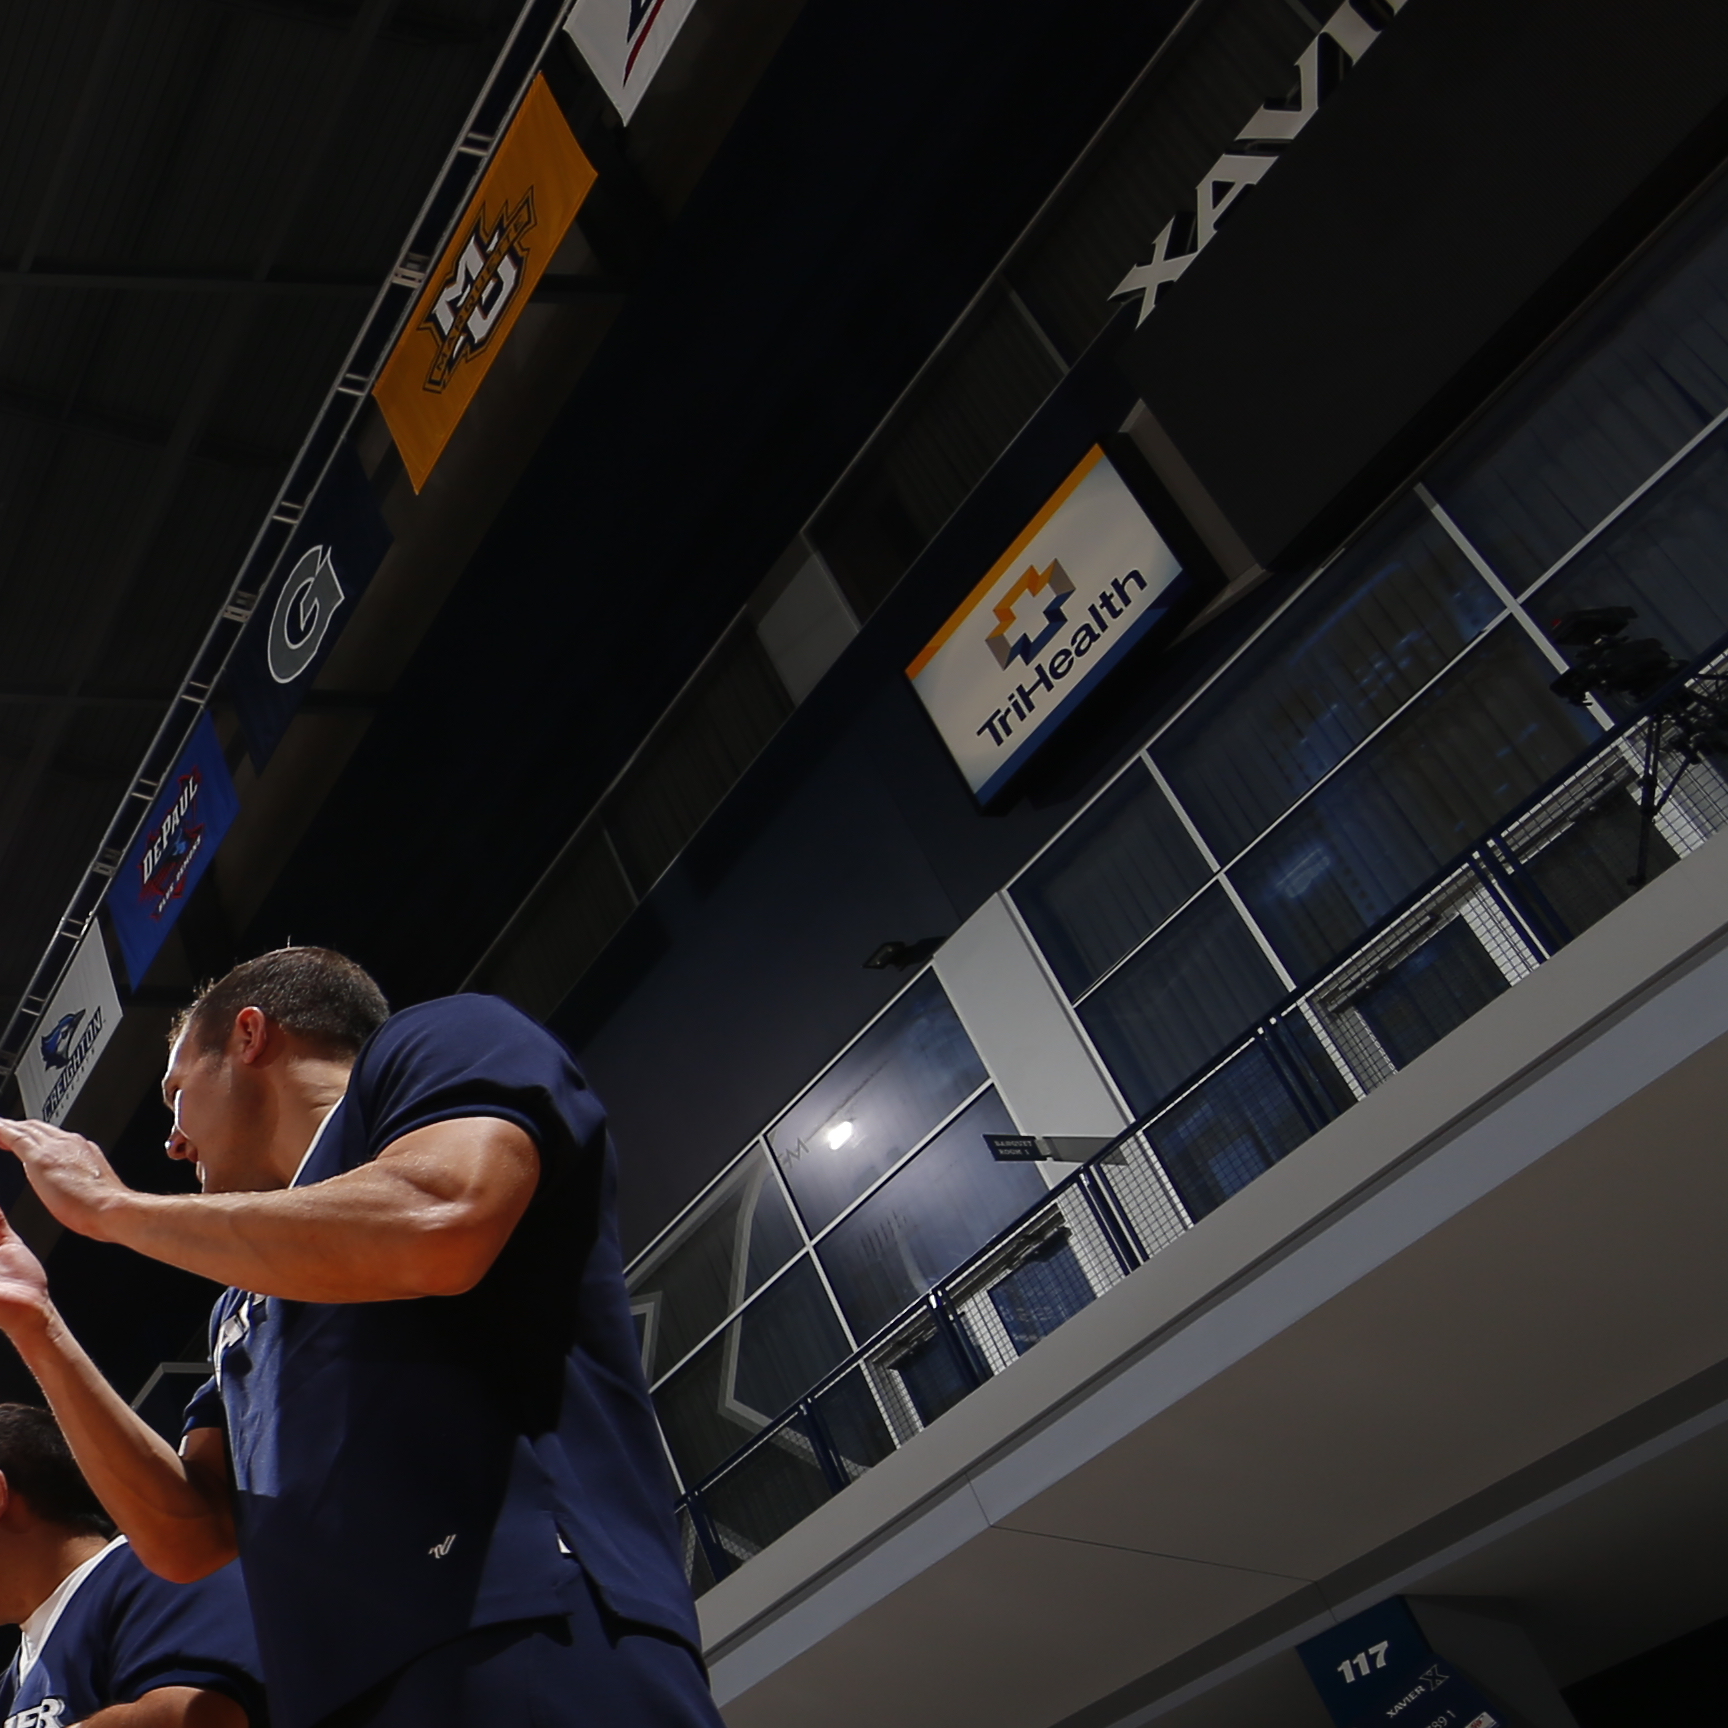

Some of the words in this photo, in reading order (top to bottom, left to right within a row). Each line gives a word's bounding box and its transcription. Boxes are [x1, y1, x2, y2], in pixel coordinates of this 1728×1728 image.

[1106, 0, 1411, 332] XAVI
[976, 569, 1148, 747] TriHealth
[42, 1005, 103, 1123] CREIGHTON
[1337, 1640, 1389, 1684] 117
[1385, 1685, 1426, 1719] XAVIER
